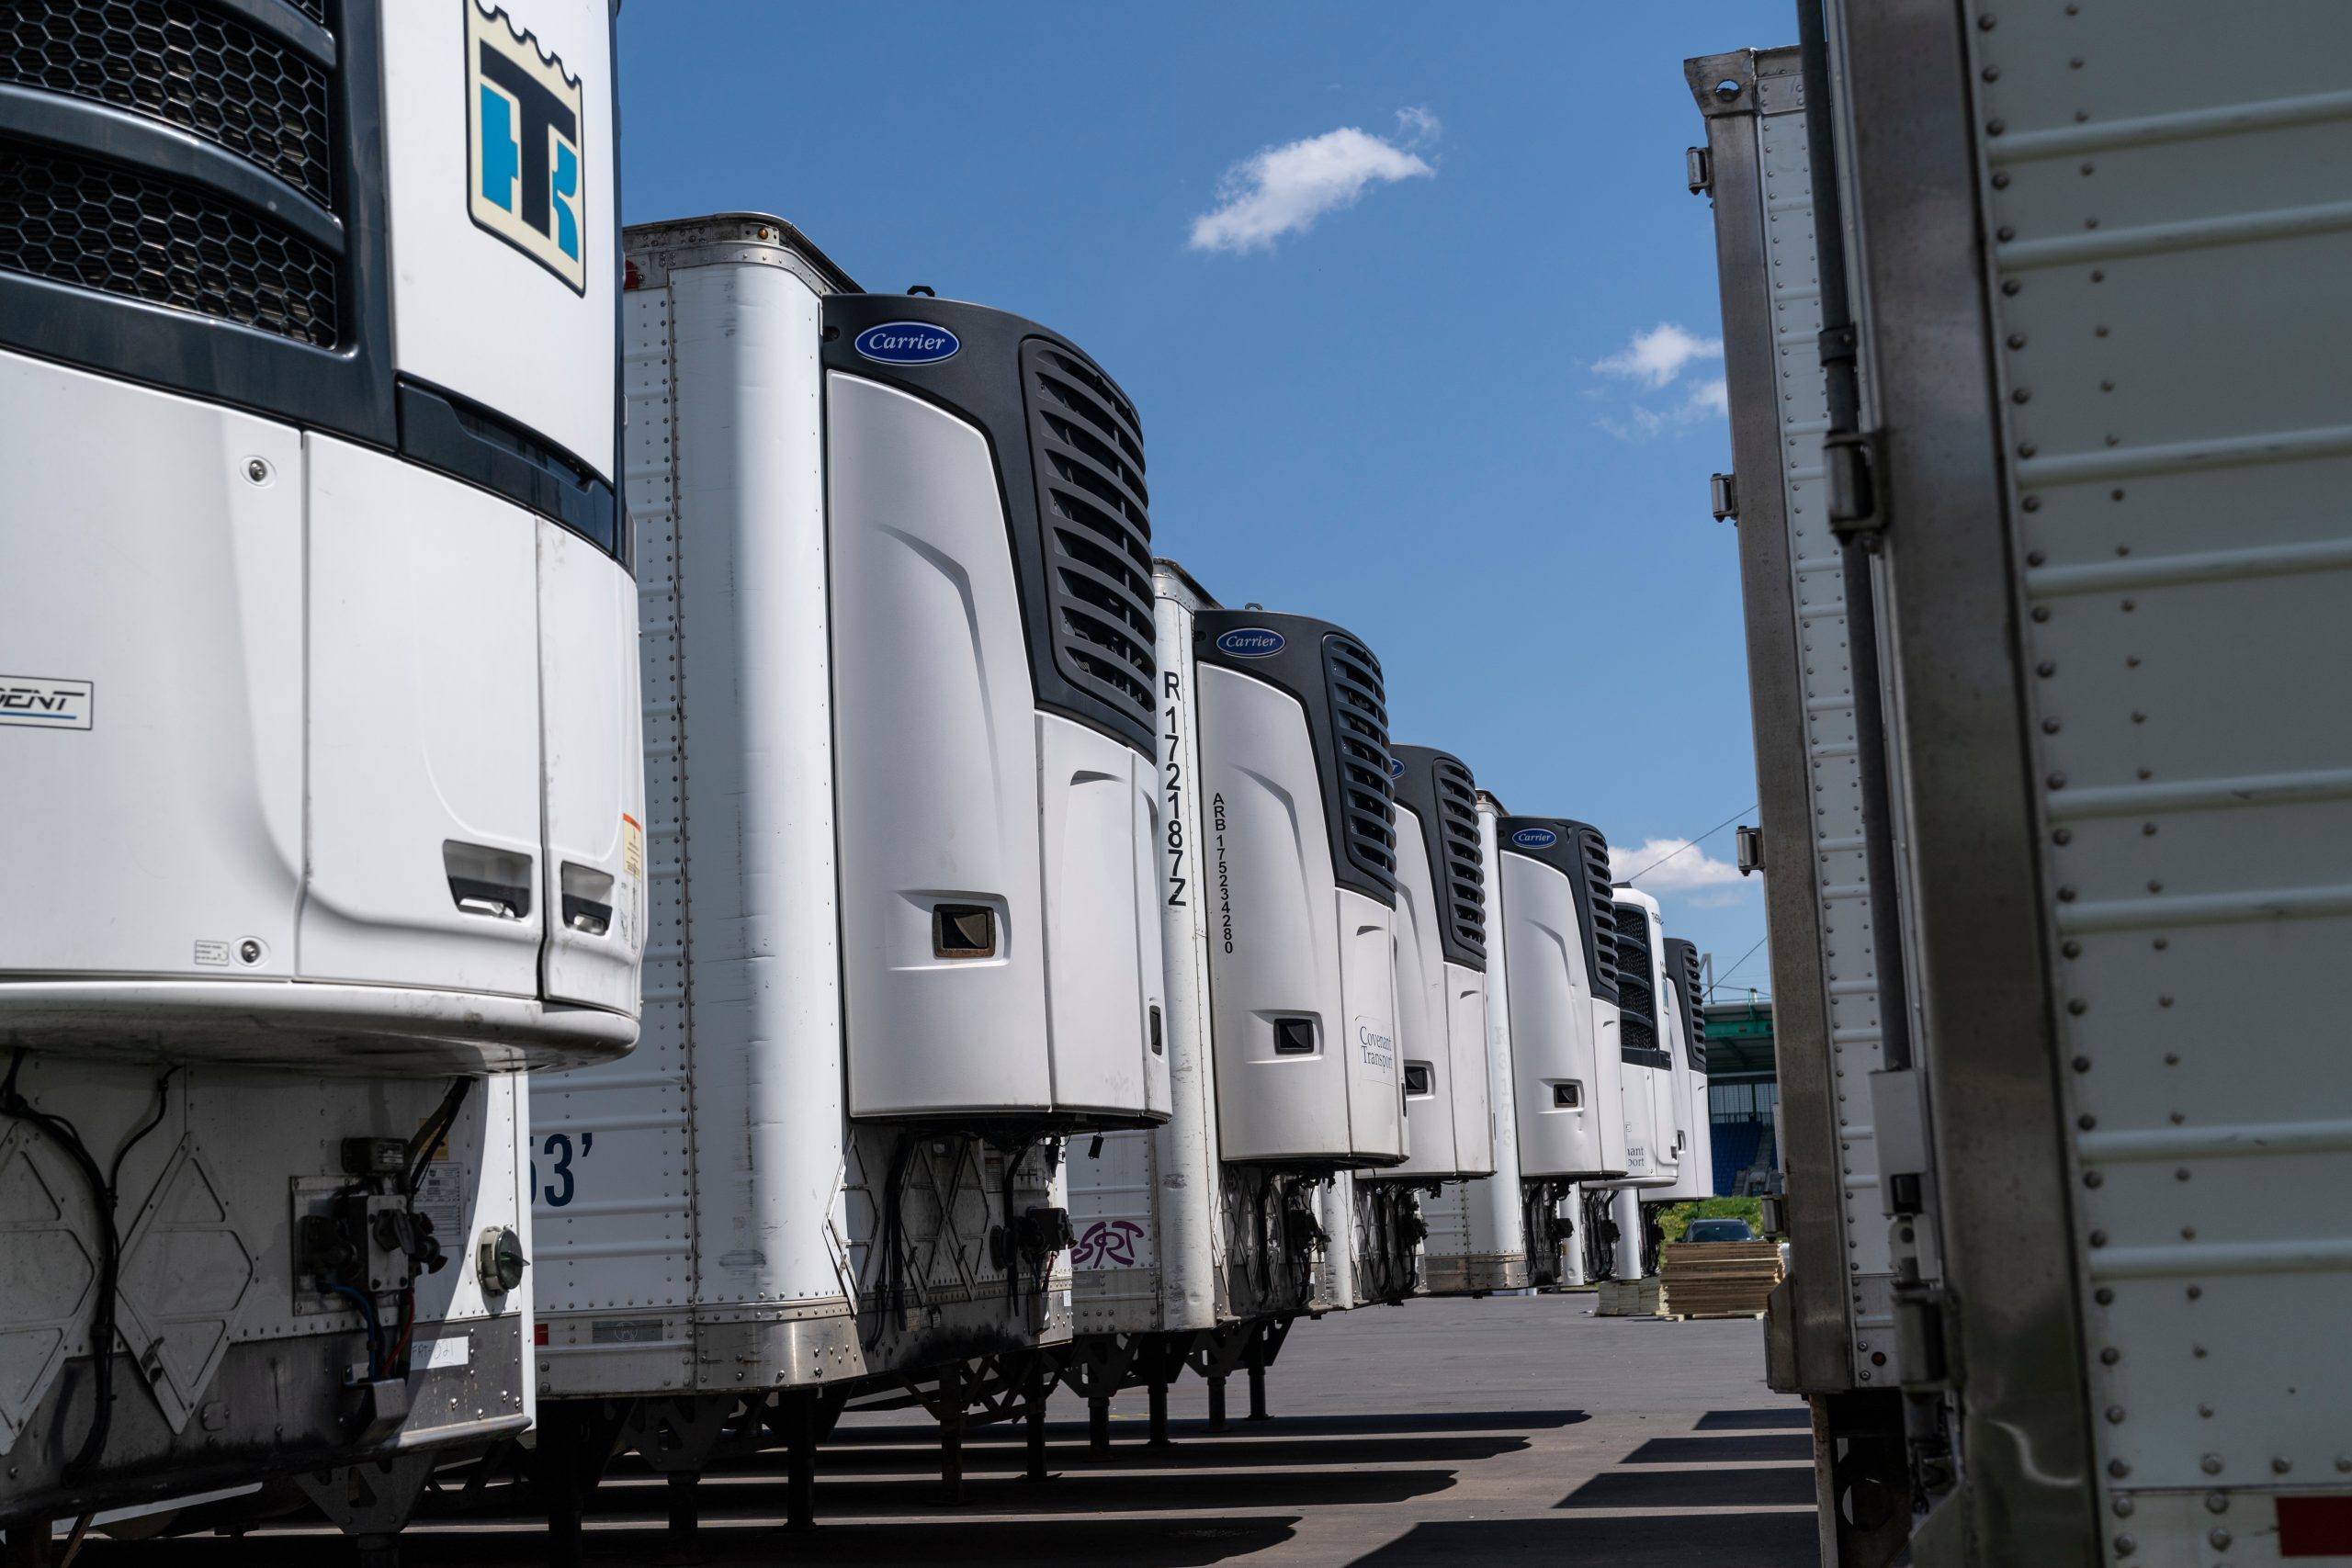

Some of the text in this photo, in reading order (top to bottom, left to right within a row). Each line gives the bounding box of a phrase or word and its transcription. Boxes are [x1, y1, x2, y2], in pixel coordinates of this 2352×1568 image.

[869, 333, 946, 350] Carrier
[1226, 636, 1276, 648] Carrier
[0, 687, 85, 711] ENT
[1518, 833, 1552, 841] Carrier
[1360, 1025, 1392, 1052] Covenant
[1361, 1045, 1393, 1074] Transport
[530, 1132, 593, 1208] 3'
